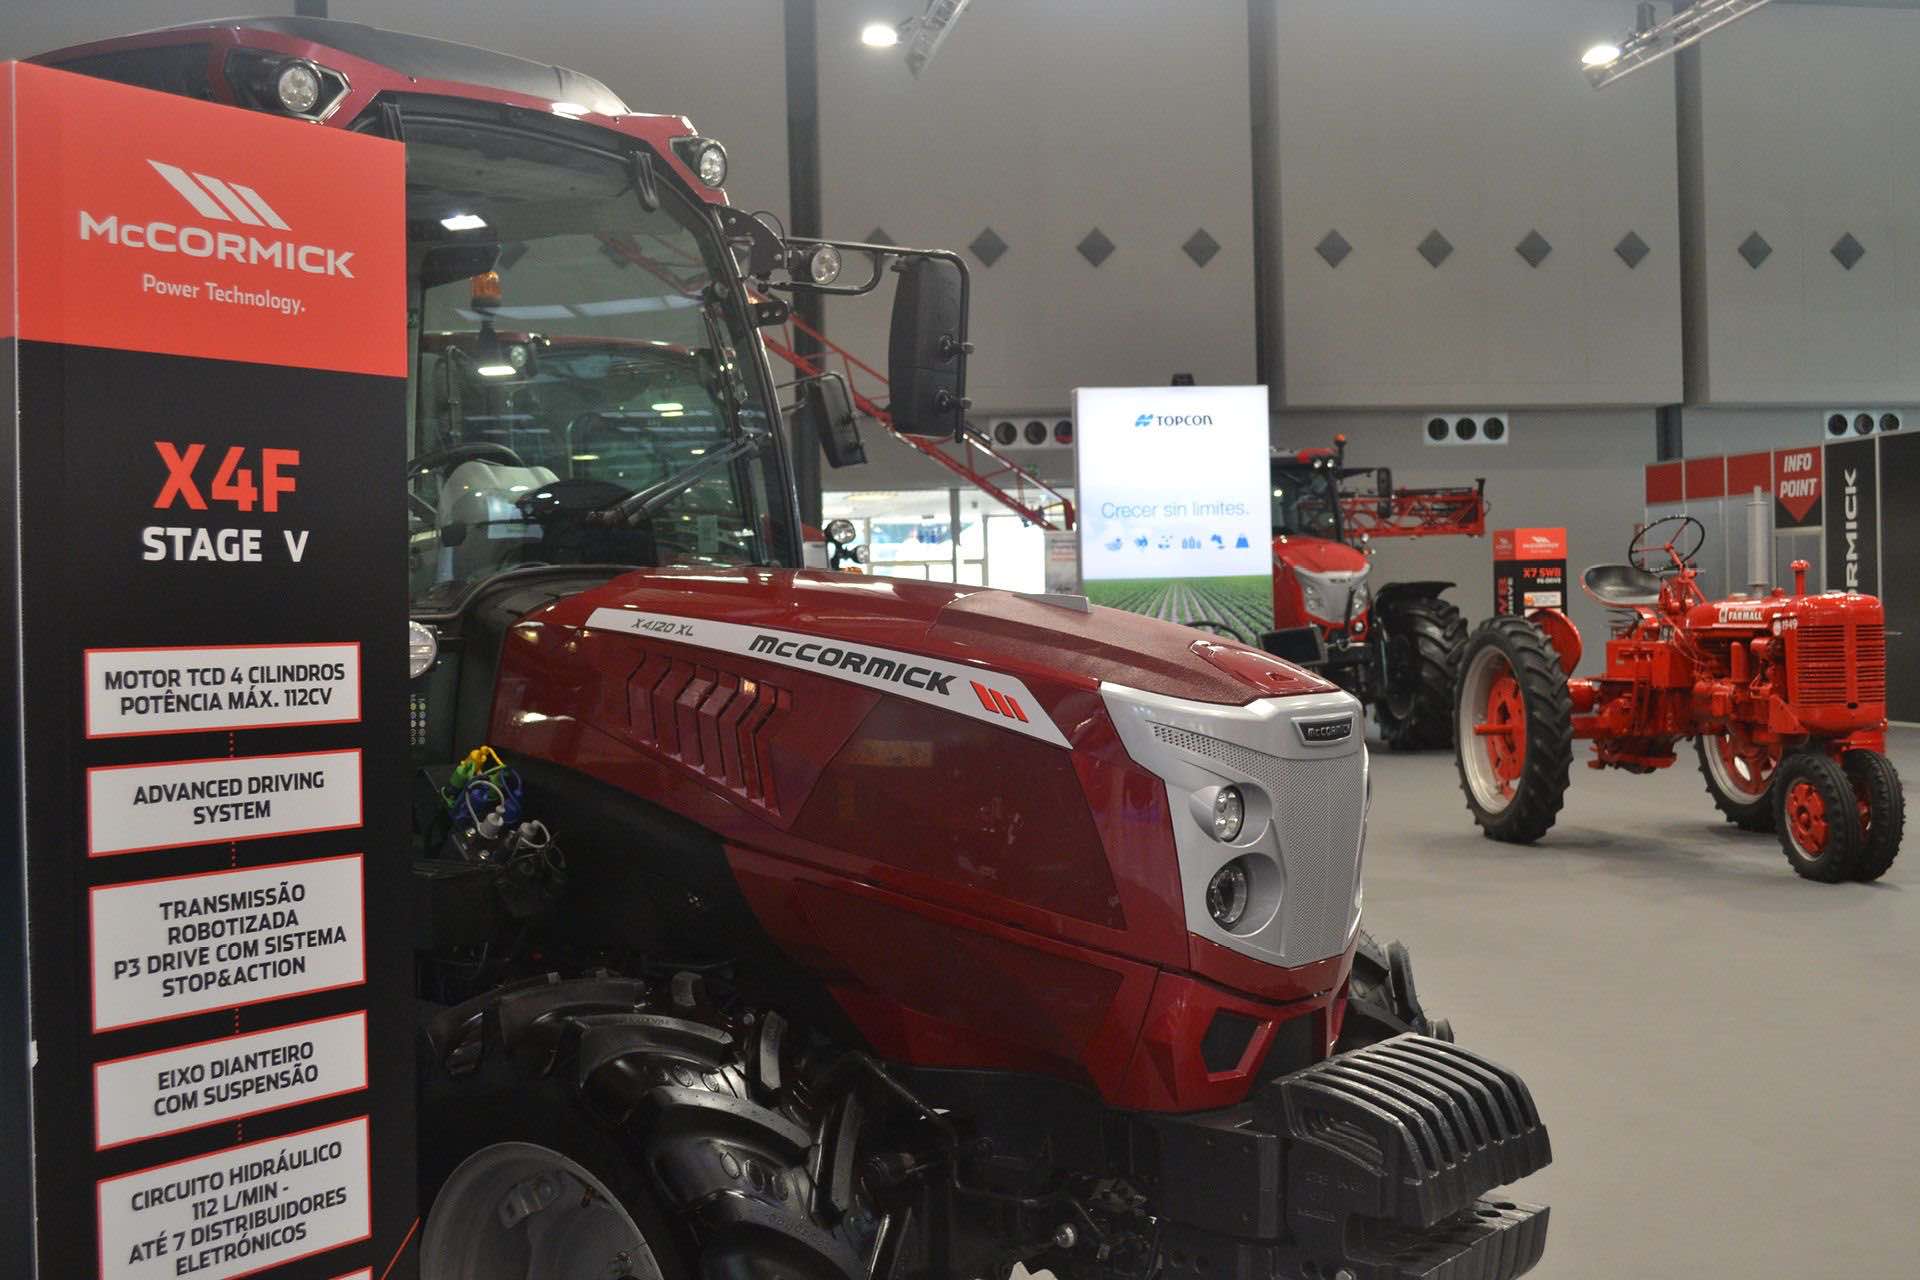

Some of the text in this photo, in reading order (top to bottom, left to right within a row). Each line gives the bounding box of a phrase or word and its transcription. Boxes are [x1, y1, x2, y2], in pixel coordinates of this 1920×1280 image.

[143, 273, 306, 315] Power Technology.
[1156, 414, 1213, 427] TOPCON
[153, 441, 300, 513] X4F
[1784, 453, 1812, 473] INFO
[1780, 478, 1817, 498] POINT
[1101, 501, 1249, 519] Crecer sin limites.
[142, 526, 309, 563] STAGE V
[676, 624, 694, 637] XL
[1728, 610, 1762, 621] FARMALL
[105, 663, 345, 690] MOTOR TCD 4 CILINDROS
[120, 685, 332, 716] POTÊNCIA MÁX. 112CV
[133, 771, 324, 805] ADVANCED DRIVING
[193, 800, 271, 825] SYSTEM
[160, 881, 306, 920] TRANSMISSÃO
[168, 909, 299, 945] ROBOTIZADA
[114, 925, 347, 980] P3 DRIVE COM SISTEMA
[162, 956, 305, 997] STOP&ACTION
[158, 1041, 314, 1090] EIXO DIANTEIRO
[154, 1064, 318, 1116] COM SUSPENSÃO
[131, 1141, 342, 1211] CIRCUITO HIDRÁULICO
[192, 1198, 218, 1220] 112
[223, 1181, 278, 1212] L/MIN
[128, 1187, 347, 1264] ATÉ 7 DISTRIBUIDORES
[175, 1222, 307, 1276] ELETRÓNICOS
